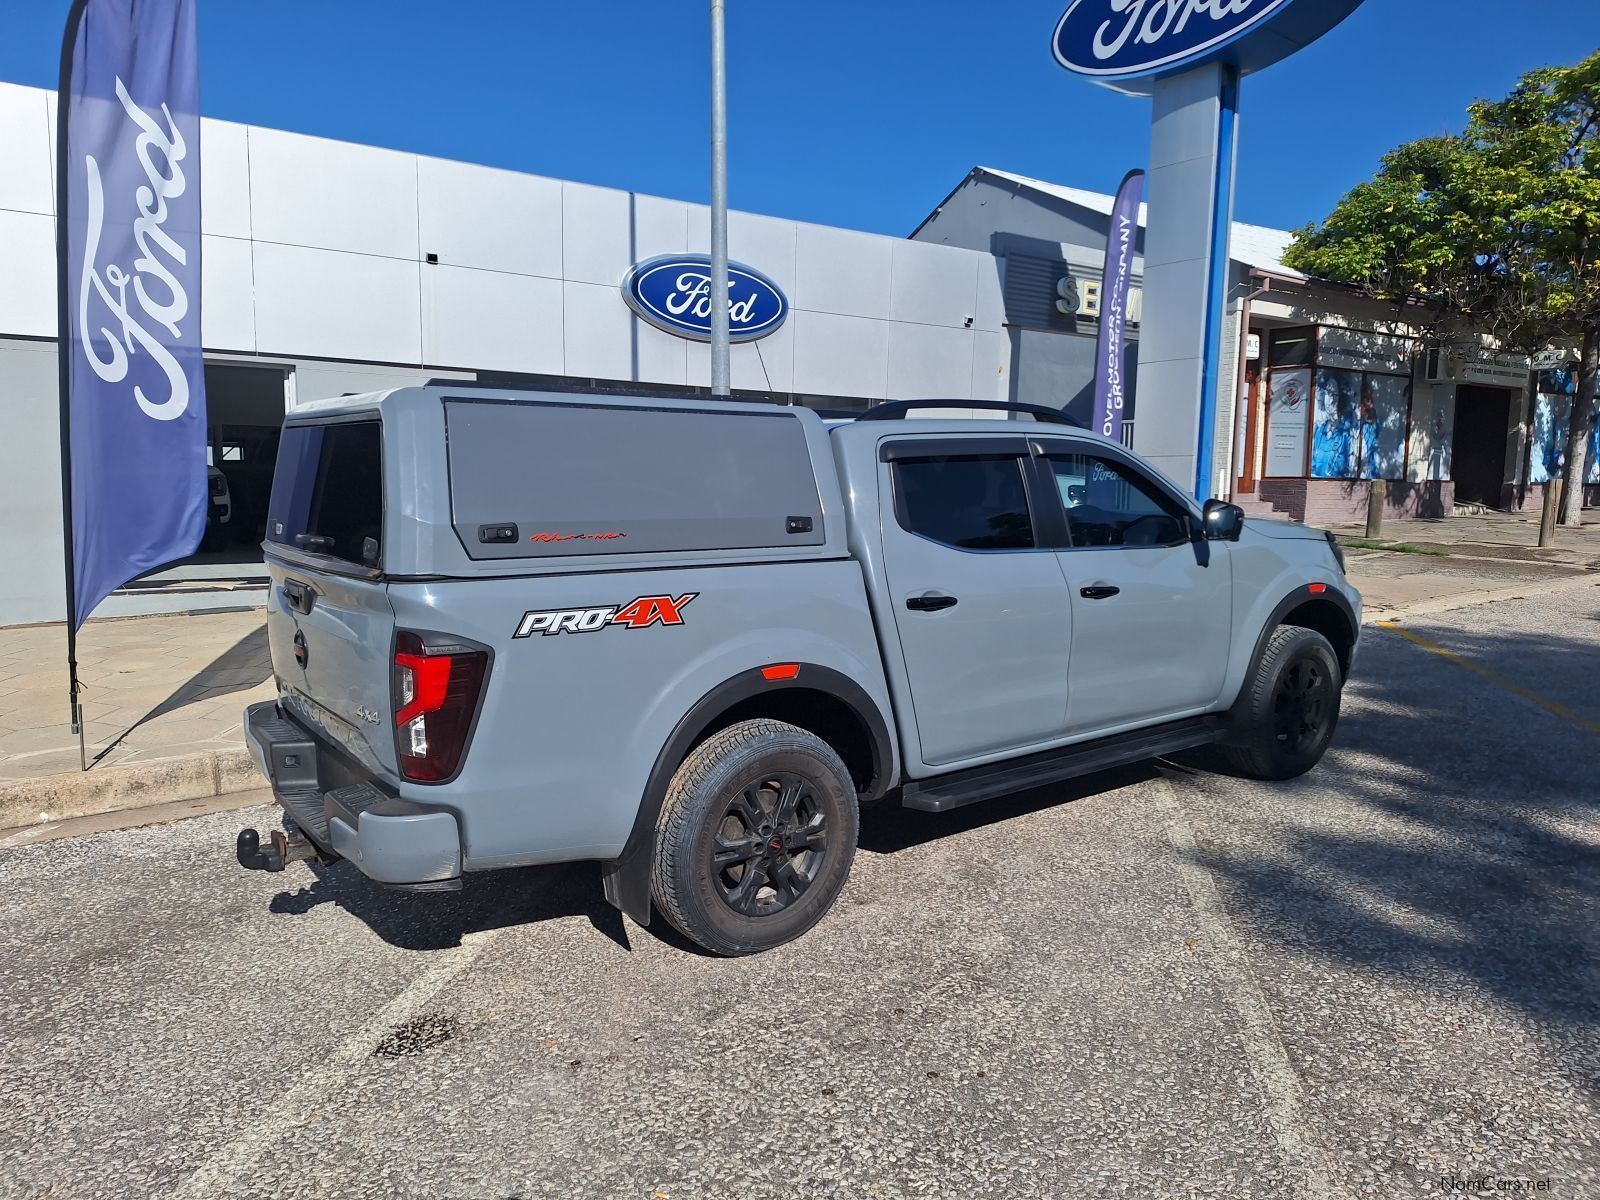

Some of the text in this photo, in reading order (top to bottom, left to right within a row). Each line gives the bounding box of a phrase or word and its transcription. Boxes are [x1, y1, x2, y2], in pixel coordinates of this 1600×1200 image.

[80, 75, 189, 420] Ford
[666, 272, 758, 323] Fod
[1103, 388, 1113, 437] OVEL
[512, 592, 700, 639] PRO-4X
